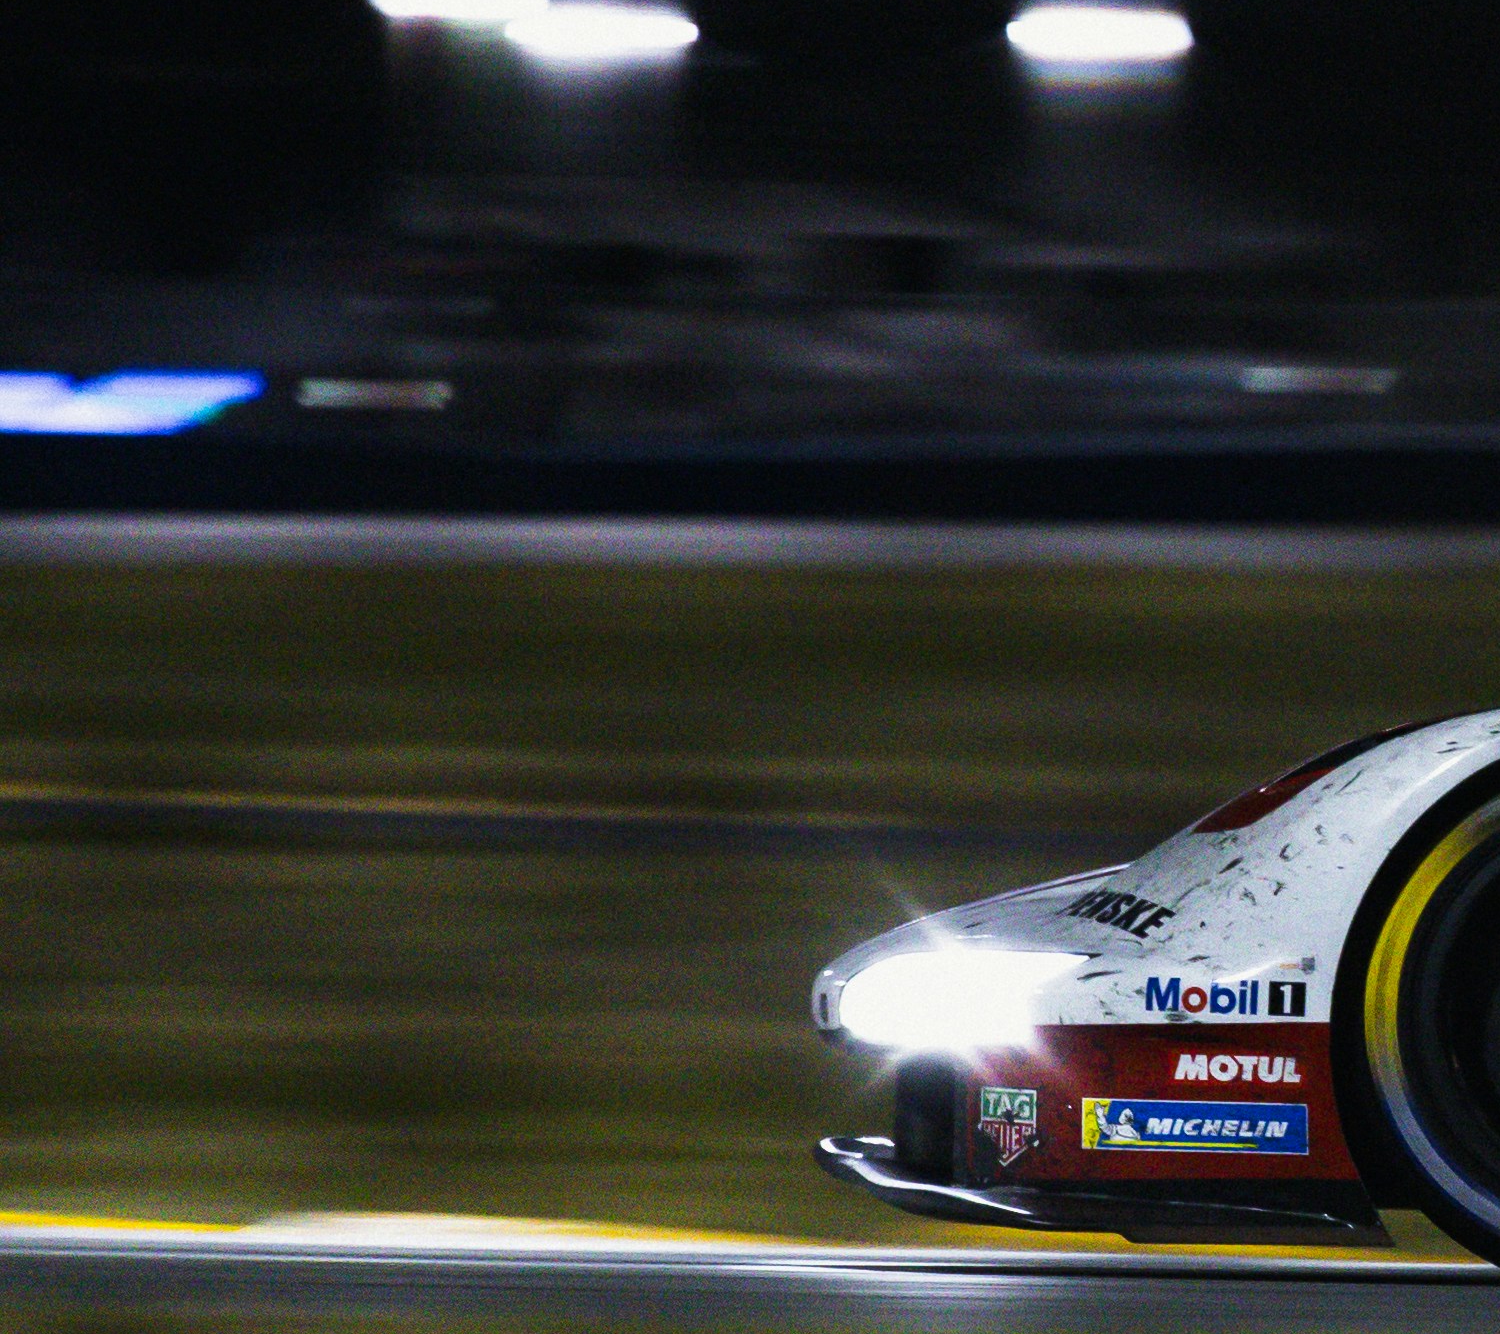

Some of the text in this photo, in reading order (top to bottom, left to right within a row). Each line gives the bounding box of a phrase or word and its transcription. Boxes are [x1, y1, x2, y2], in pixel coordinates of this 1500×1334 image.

[1146, 977, 1259, 1015] Mobil
[1174, 1053, 1302, 1083] MOTUL
[985, 1092, 1031, 1118] TAG
[1145, 1117, 1289, 1138] MICHELIN
